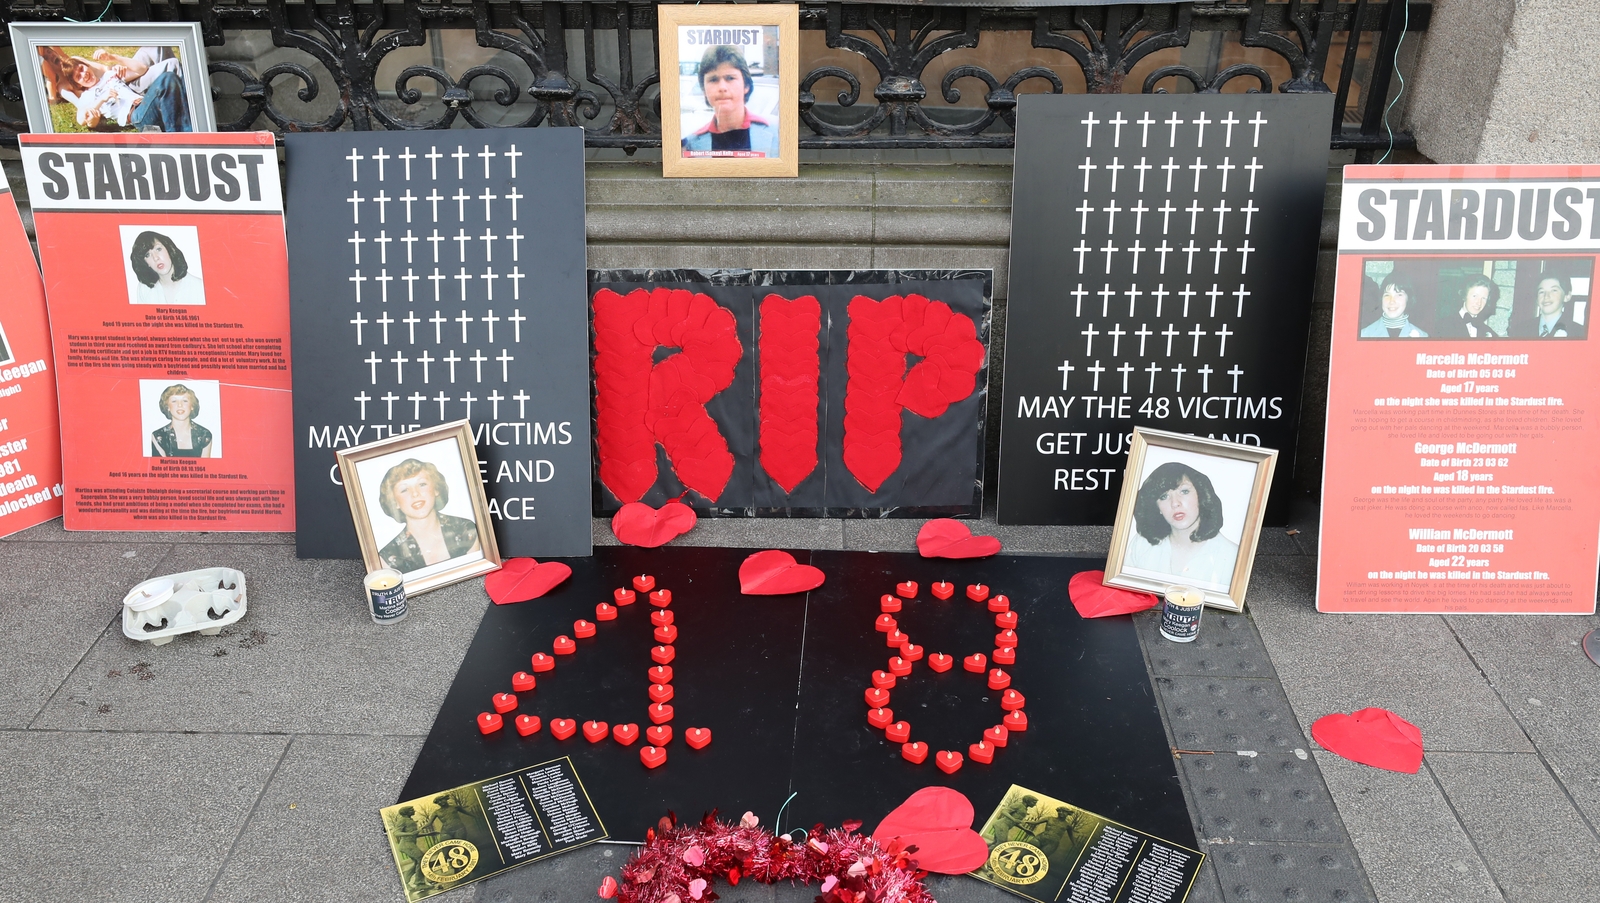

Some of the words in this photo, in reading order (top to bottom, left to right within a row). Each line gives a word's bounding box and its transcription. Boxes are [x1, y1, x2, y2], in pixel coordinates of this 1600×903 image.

[687, 29, 760, 45] STARDUST
[38, 152, 264, 202] STARDUST
[1356, 187, 1600, 242] STARDUST
[1416, 353, 1465, 364] Marcella
[1467, 353, 1528, 364] McDermott
[1426, 369, 1445, 378] Date
[1447, 369, 1455, 378] of
[1457, 369, 1478, 378] Birth
[1479, 369, 1490, 378] 05
[1491, 369, 1503, 378] 03
[1504, 369, 1515, 378] 64
[1440, 383, 1462, 393] Aged
[1464, 381, 1474, 392] 17
[1475, 385, 1499, 393] years
[592, 287, 985, 503] RIP
[1374, 398, 1385, 406] on
[1386, 397, 1400, 406] the
[1401, 397, 1423, 406] night
[1424, 397, 1440, 406] she
[1441, 398, 1458, 406] was
[1459, 397, 1484, 406] killed
[1485, 397, 1493, 405] in
[1495, 397, 1509, 406] the
[1510, 396, 1546, 406] Stardust
[1547, 396, 1564, 405] fire.
[1017, 396, 1076, 418] MAY
[1081, 396, 1132, 418] THE
[1138, 397, 1170, 419] 48
[1177, 396, 1283, 419] VICTIMS
[308, 424, 365, 448] MAY
[473, 421, 573, 446] VICTIMS
[1036, 432, 1087, 455] GET
[1414, 442, 1454, 455] George
[1456, 442, 1517, 454] McDermott
[179, 459, 197, 467] Keegan
[1420, 457, 1439, 466] Date
[1441, 457, 1449, 466] of
[1451, 457, 1472, 466] Birth
[1473, 457, 1483, 466] 23
[1485, 457, 1496, 466] 03
[1497, 457, 1508, 466] 62
[495, 459, 555, 483] AND
[1433, 472, 1454, 482] Aged
[1456, 469, 1468, 481] 18
[1470, 473, 1493, 482] years
[0, 473, 38, 497] death
[1054, 468, 1117, 490] REST
[1371, 486, 1382, 494] on
[1383, 485, 1396, 494] the
[1398, 485, 1420, 495] night
[1421, 485, 1432, 494] he
[1433, 486, 1450, 494] was
[1451, 485, 1475, 494] killed
[1476, 485, 1484, 494] in
[1486, 485, 1500, 494] the
[1501, 485, 1536, 494] Stardust
[1538, 485, 1555, 494] fire.
[488, 497, 536, 520] ACE
[1408, 528, 1451, 539] William
[1453, 528, 1513, 540] McDermott
[1416, 543, 1435, 552] Date
[1436, 543, 1445, 552] of
[1446, 543, 1466, 552] Birth
[1468, 543, 1479, 552] 20
[1480, 543, 1491, 552] 03
[1492, 543, 1504, 552] 58
[1428, 557, 1450, 567] Aged
[1451, 555, 1465, 566] 22
[1466, 559, 1489, 567] years
[1367, 571, 1378, 579] on
[1379, 570, 1393, 579] the
[1394, 570, 1416, 580] night
[1417, 570, 1428, 579] he
[1429, 571, 1446, 579] was
[1447, 570, 1471, 579] killed
[1472, 570, 1480, 579] in
[1481, 570, 1495, 579] the
[1497, 570, 1532, 579] Stardust
[1533, 571, 1549, 579] fire.
[1164, 622, 1188, 633] Coolock
[431, 846, 469, 873] 48
[998, 849, 1040, 877] 48
